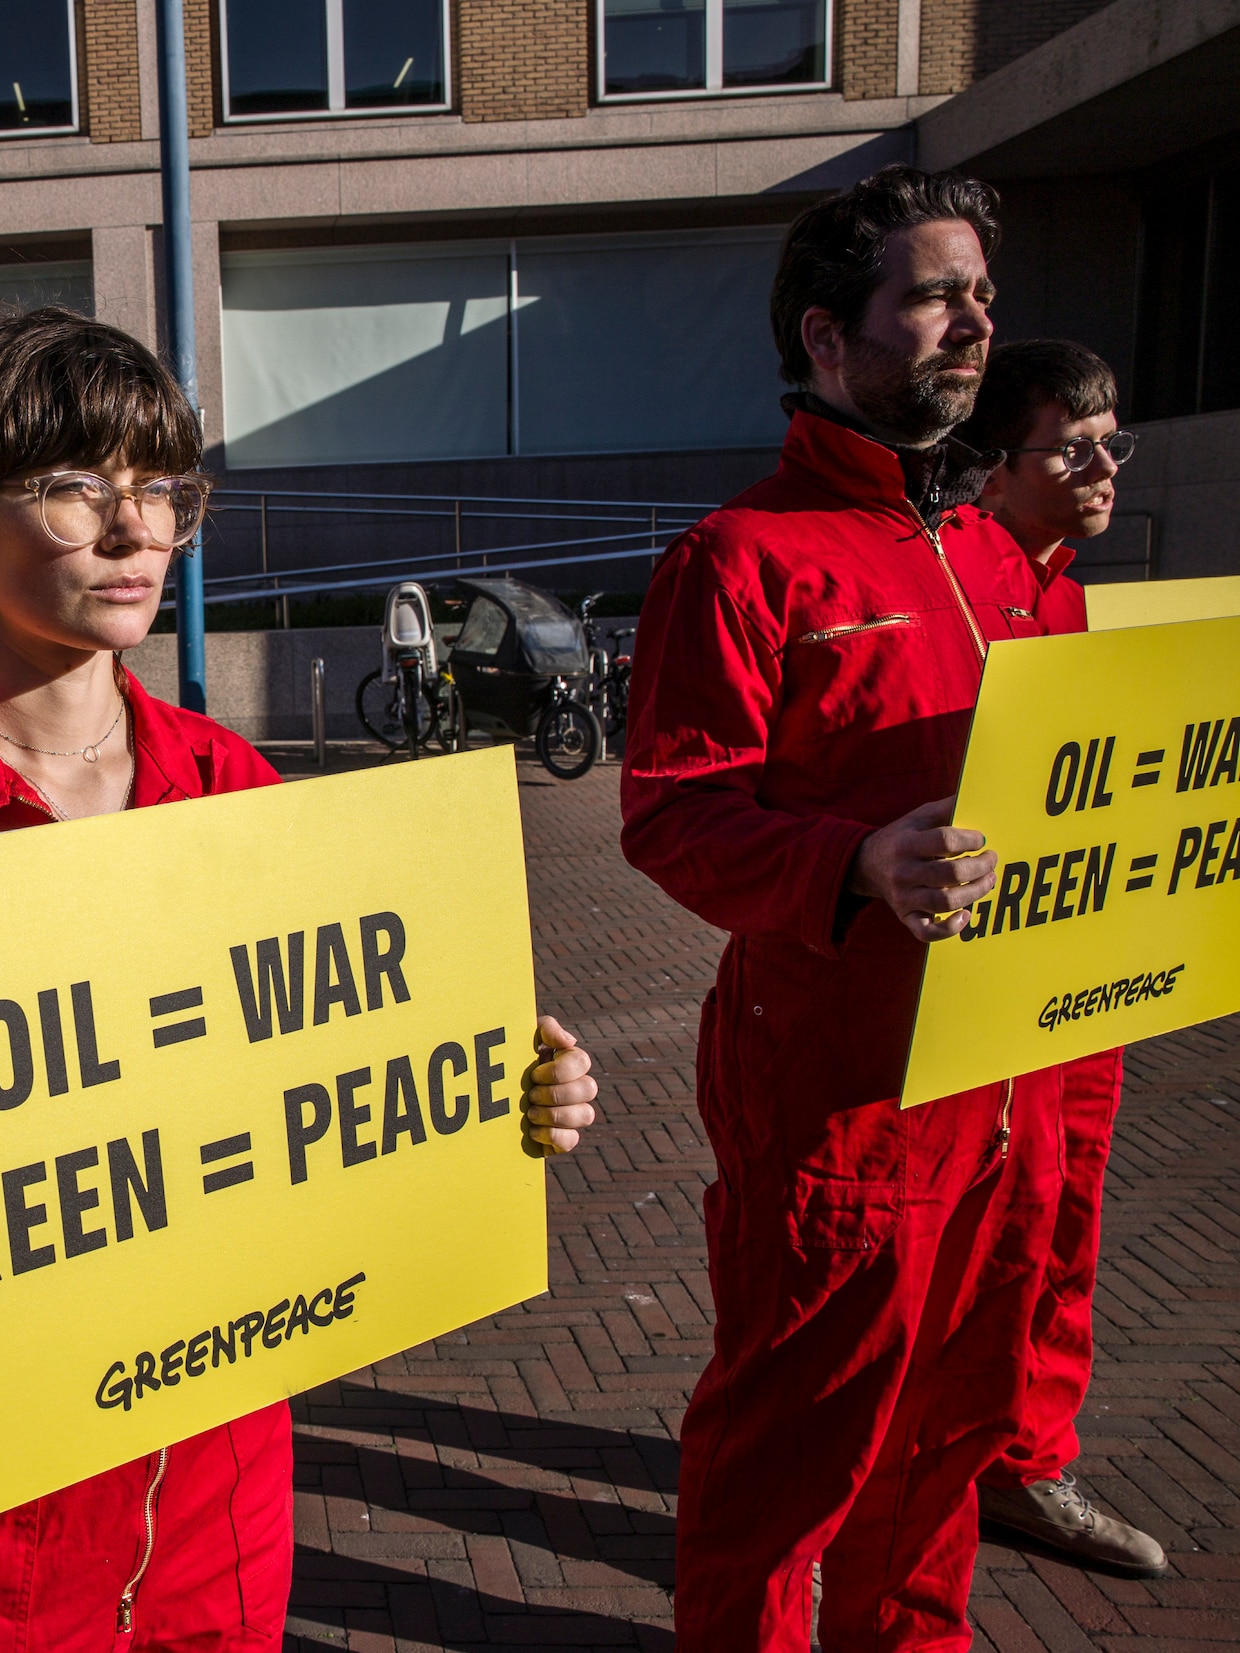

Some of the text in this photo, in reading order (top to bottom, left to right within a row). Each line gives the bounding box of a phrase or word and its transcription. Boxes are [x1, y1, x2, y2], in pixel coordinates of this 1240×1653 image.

[1045, 736, 1116, 817] OIL
[1176, 716, 1240, 793] WA
[229, 911, 411, 1043] WAR
[1037, 963, 1185, 1033] GREENPEACE
[284, 1026, 511, 1185] PEACE
[95, 1271, 366, 1412] GREENPEACE
